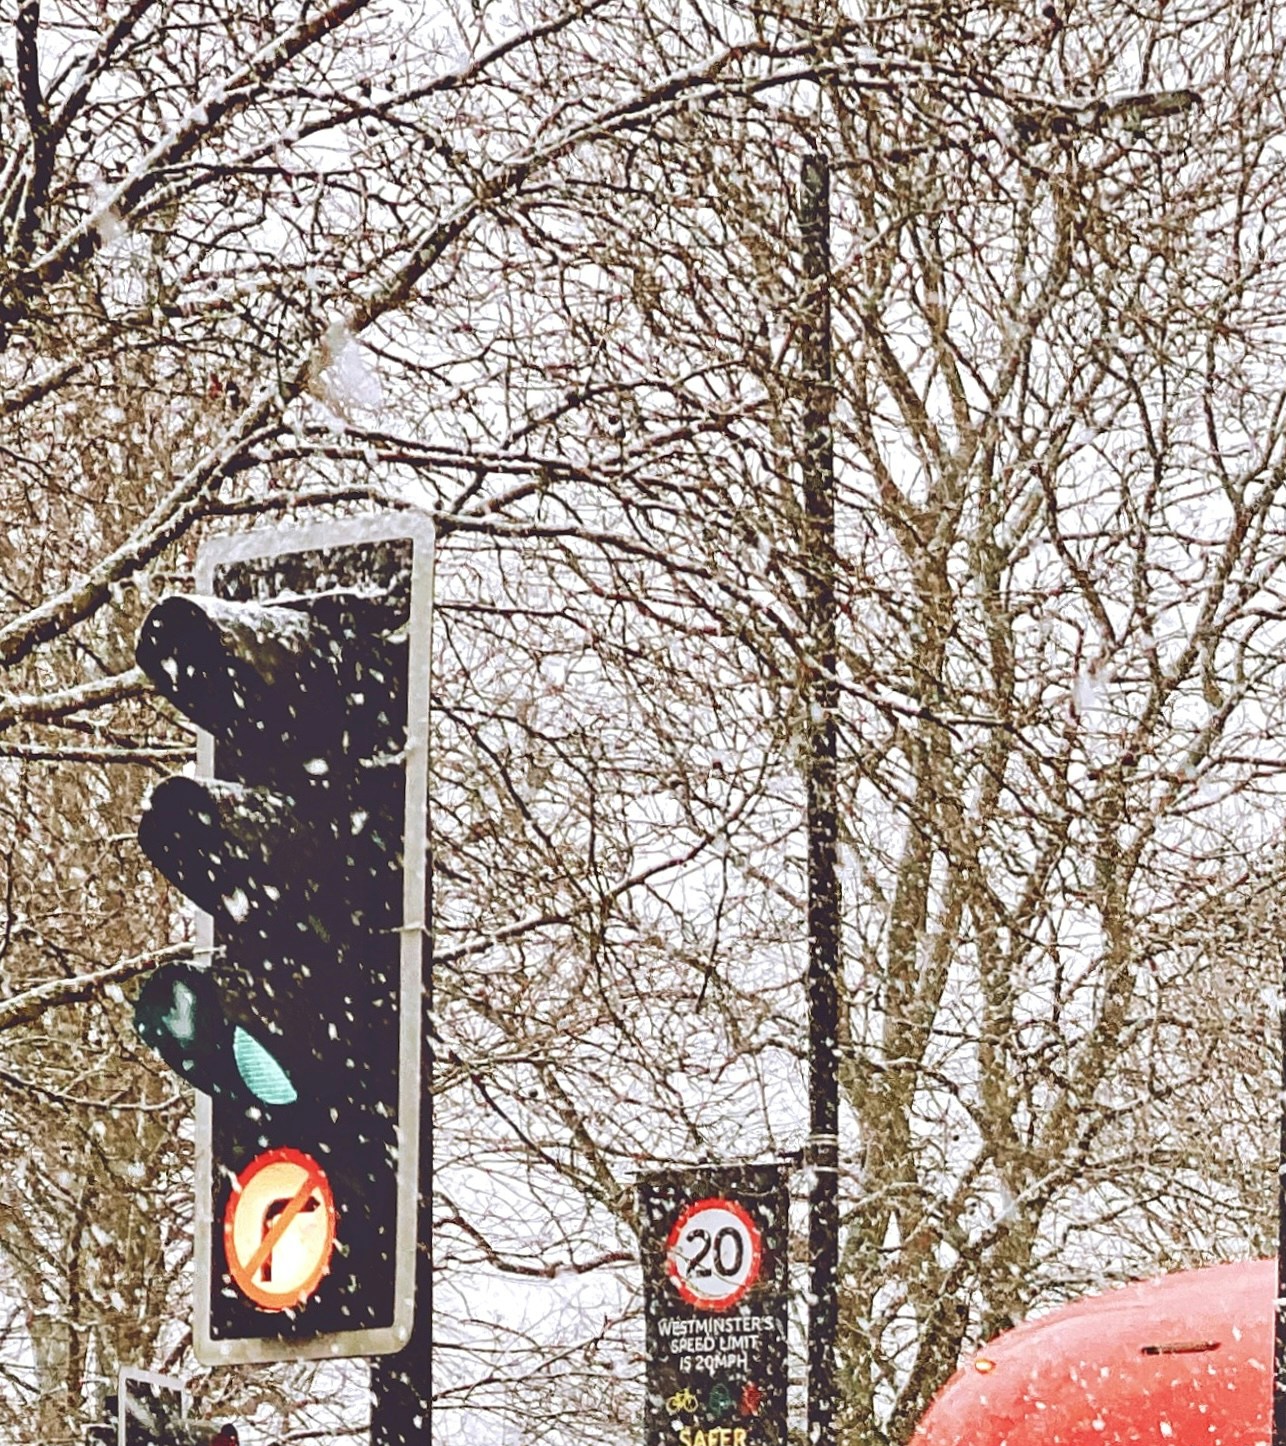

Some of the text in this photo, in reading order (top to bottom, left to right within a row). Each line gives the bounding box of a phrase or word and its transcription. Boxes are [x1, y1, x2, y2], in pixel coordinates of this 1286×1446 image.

[686, 1227, 744, 1278] 20
[658, 1316, 775, 1336] WESTMINSTER'S
[670, 1335, 759, 1354] SPEED LIMIT
[679, 1354, 749, 1372] IS 20MPH
